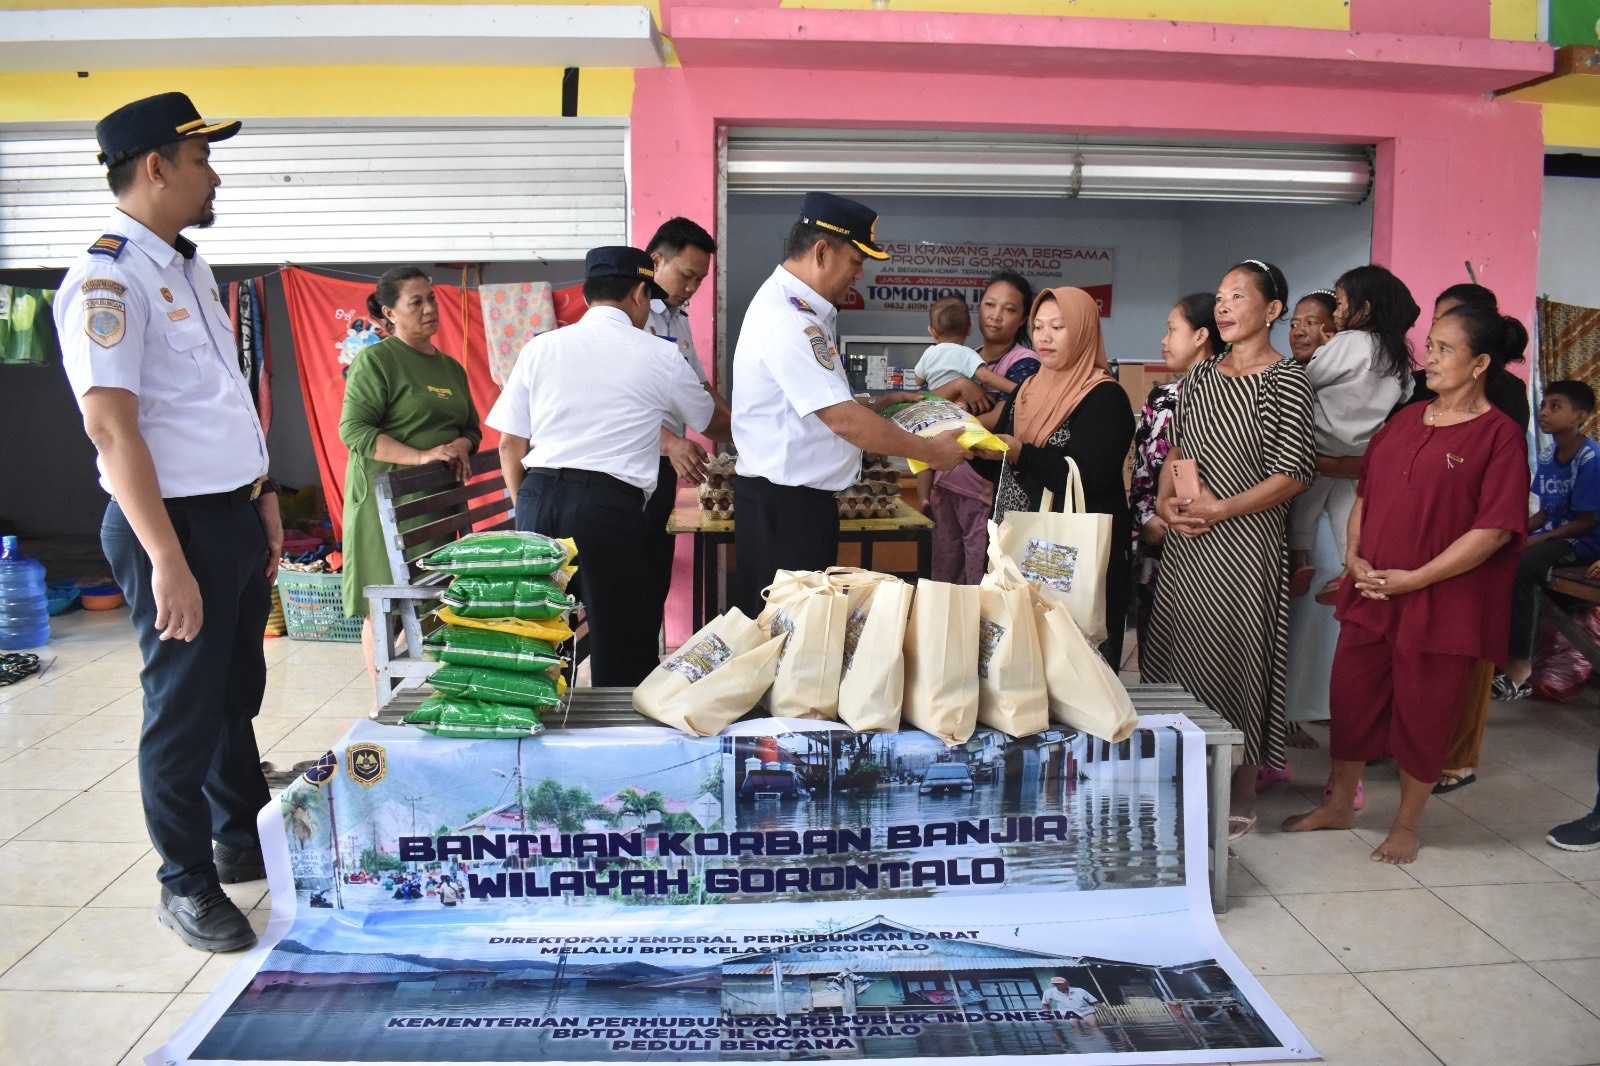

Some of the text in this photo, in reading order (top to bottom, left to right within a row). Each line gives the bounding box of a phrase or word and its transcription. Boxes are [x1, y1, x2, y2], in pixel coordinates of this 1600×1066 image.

[916, 244, 988, 257] KRAWANG
[993, 247, 1028, 257] JAYA
[1032, 247, 1110, 261] BERSAMA
[891, 255, 1061, 270] PROVINSI GORONTALO
[867, 285, 967, 303] TOMOHON
[399, 815, 1068, 862] BANTUAN KORBAN BANJIR
[468, 857, 1005, 898] WILAYAH GORONTALO
[488, 930, 980, 945] DIREKTORAT JENDERAL PERHUBUNGAN DARAT
[540, 942, 930, 955] MELALUI BPTD KELAS II GORONTALO
[387, 1009, 1084, 1028] KEMENTERIAN PERHUBUNGAN REPUBLIK INDONESIA
[552, 1024, 922, 1039] BPTD KELAS II GORONTALO
[612, 1038, 856, 1051] PEDULI BENCANA
